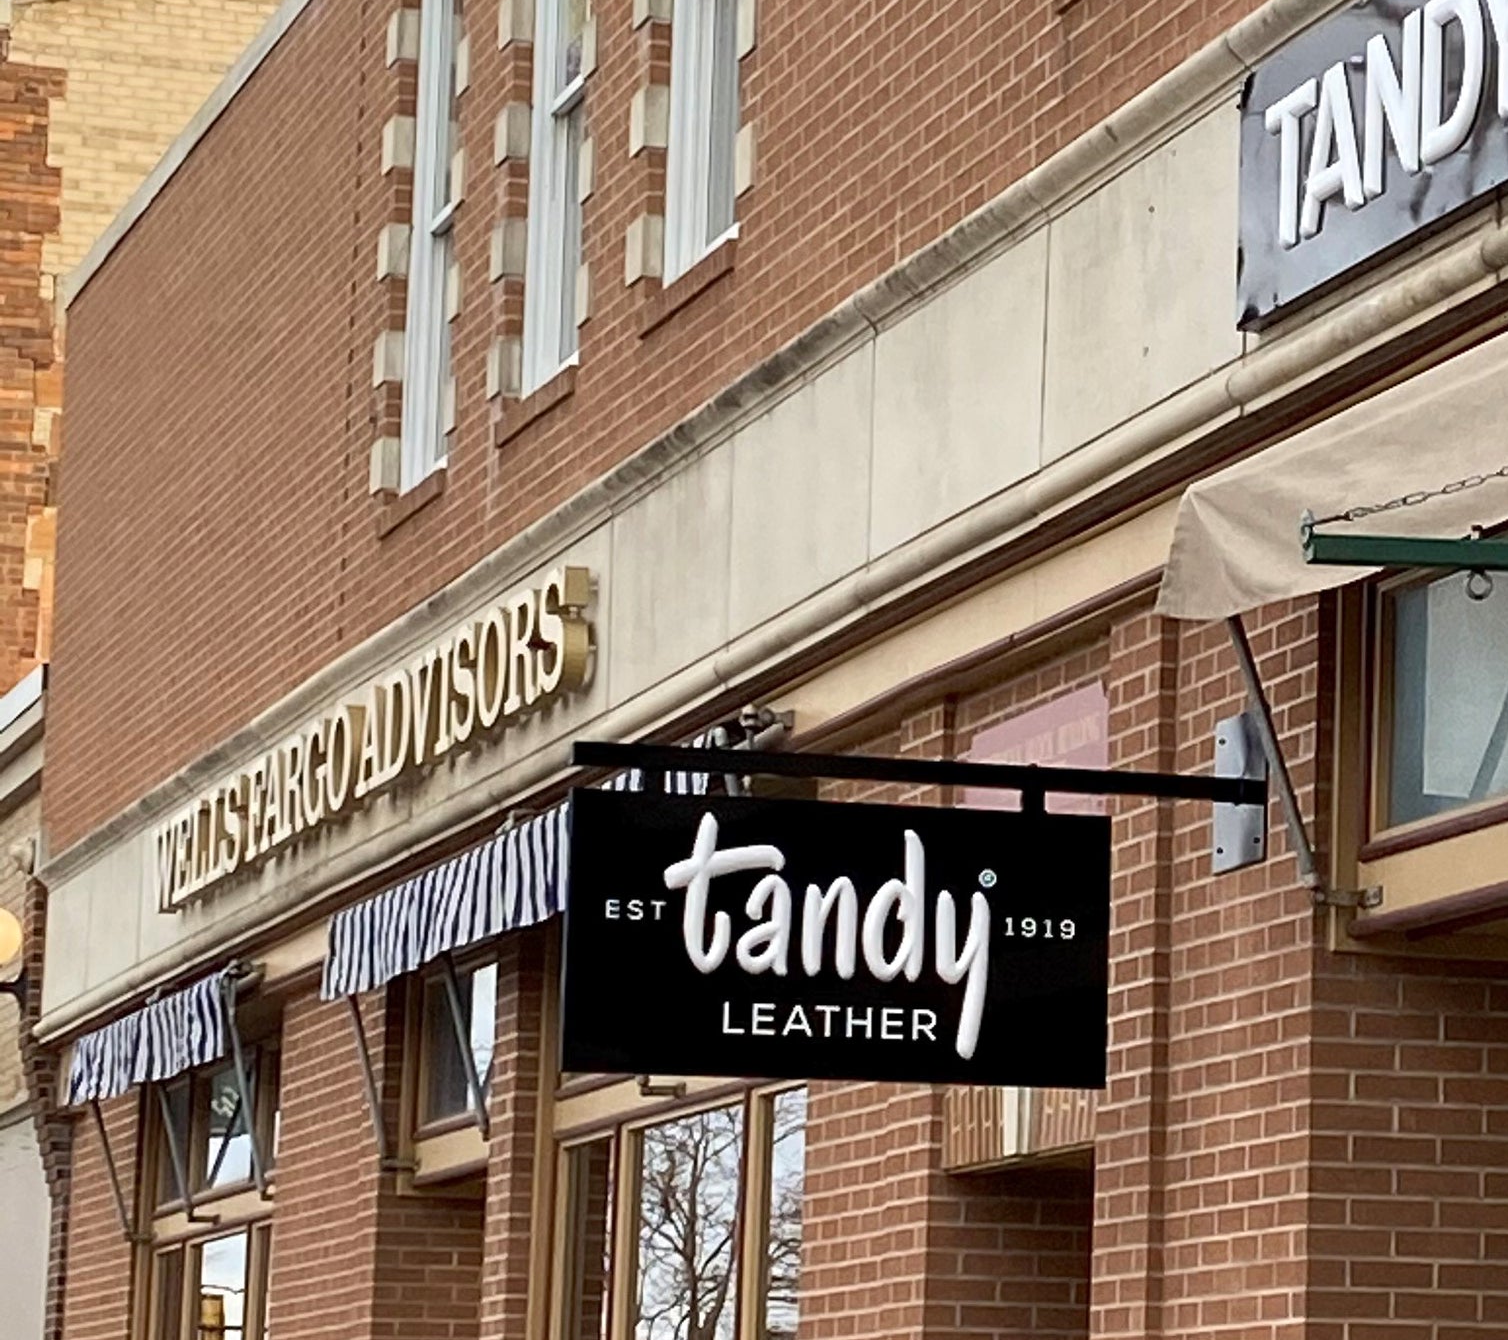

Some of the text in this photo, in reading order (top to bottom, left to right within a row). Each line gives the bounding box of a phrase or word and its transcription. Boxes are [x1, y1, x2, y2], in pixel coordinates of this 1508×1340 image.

[156, 567, 568, 914] WELLS FARGO ADVISORS
[604, 811, 1077, 1060] EST tandy 1919
[721, 1001, 938, 1042] LEATHER
